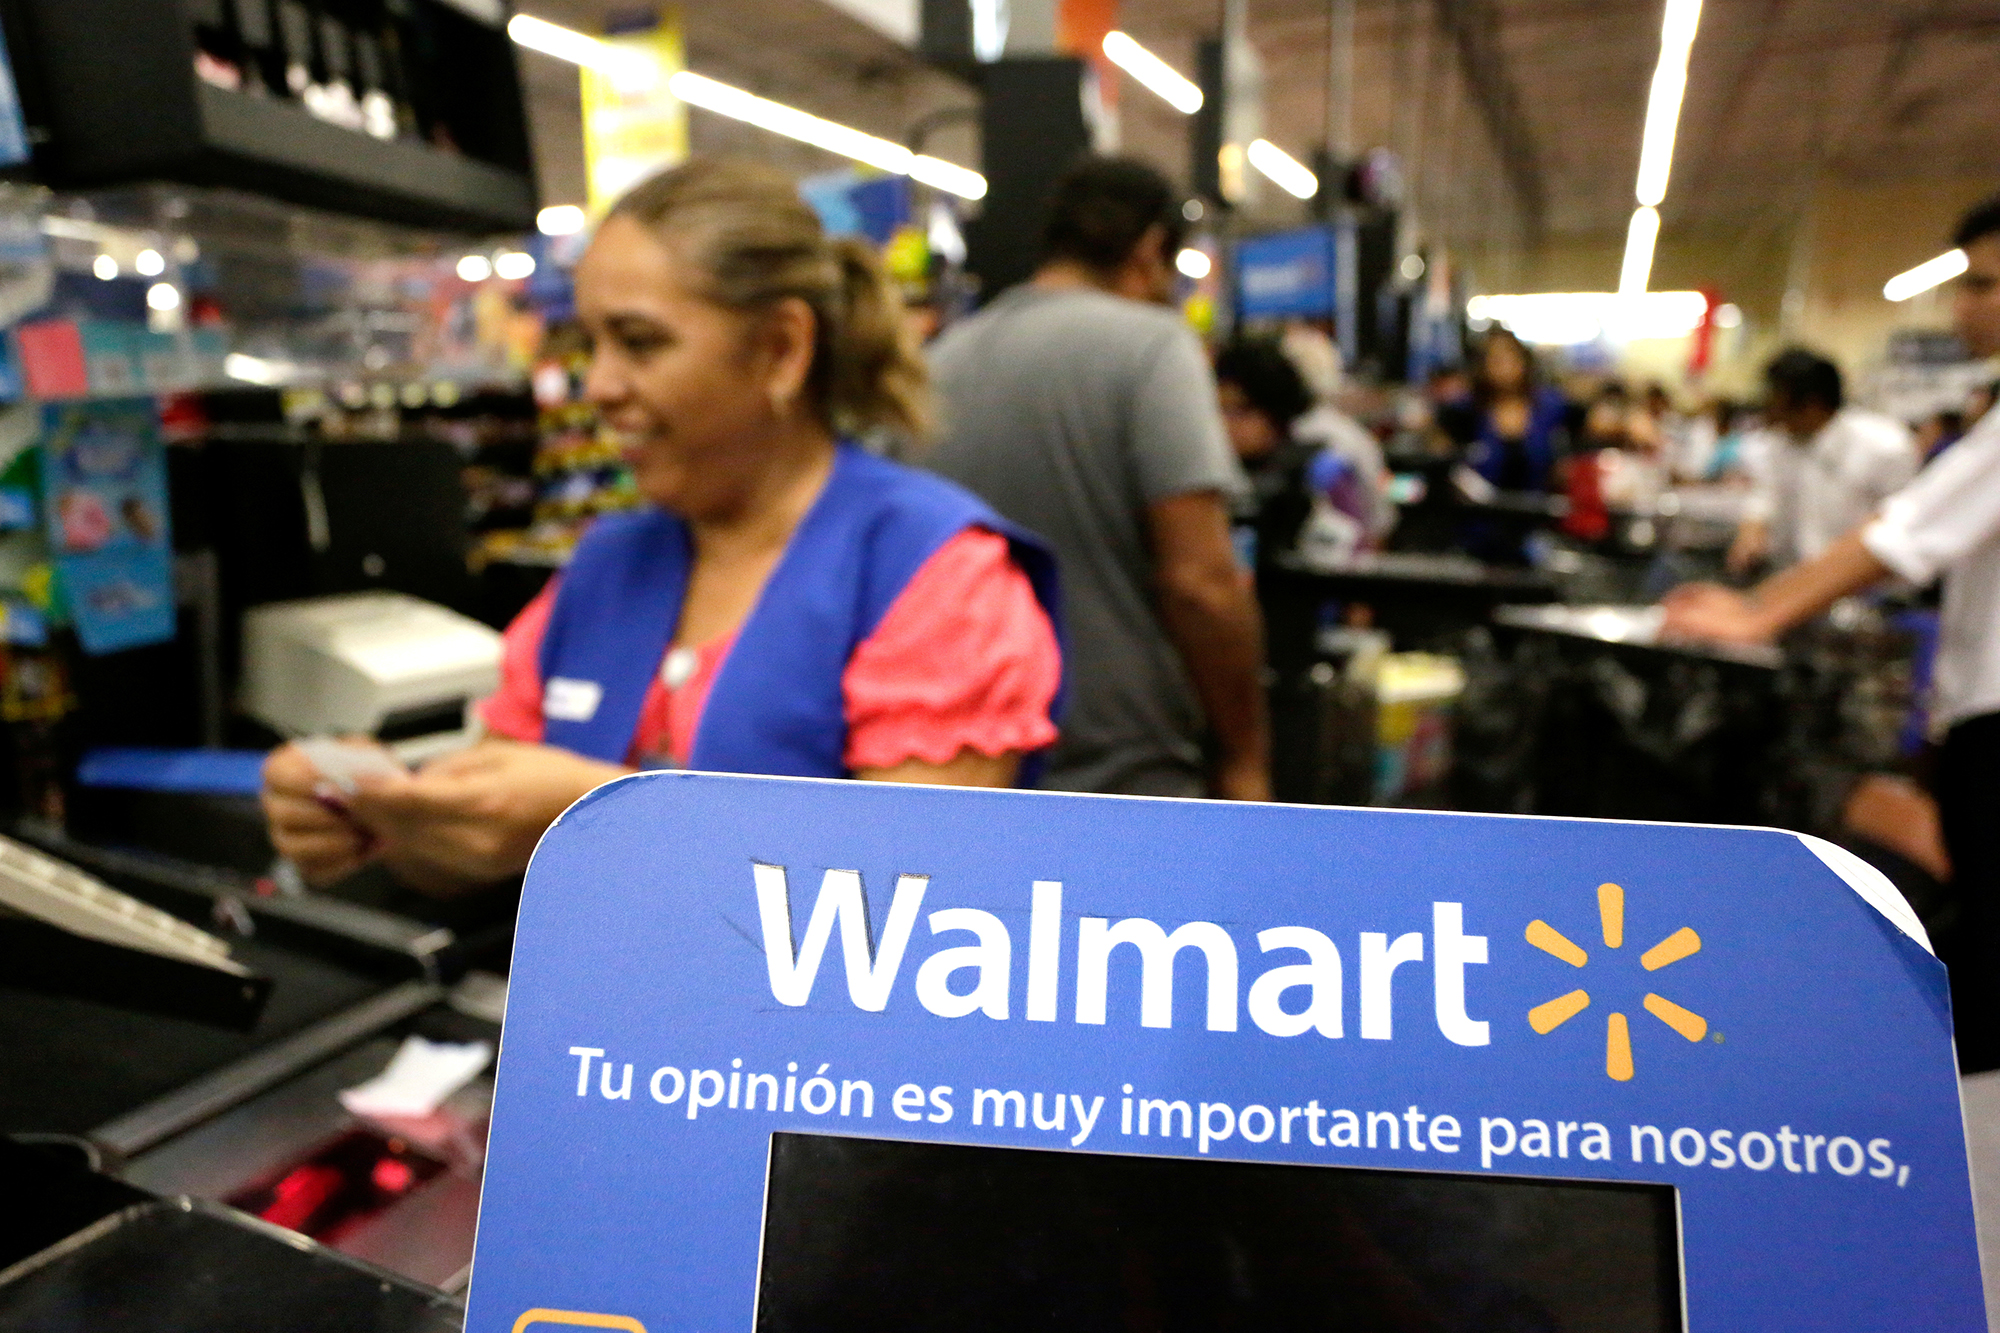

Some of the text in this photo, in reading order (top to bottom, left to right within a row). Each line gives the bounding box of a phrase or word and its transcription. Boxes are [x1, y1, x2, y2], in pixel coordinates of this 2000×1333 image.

[752, 863, 1492, 1047] Walmart
[568, 1045, 1911, 1189] Tu opinión es muy importante para nosotros,
